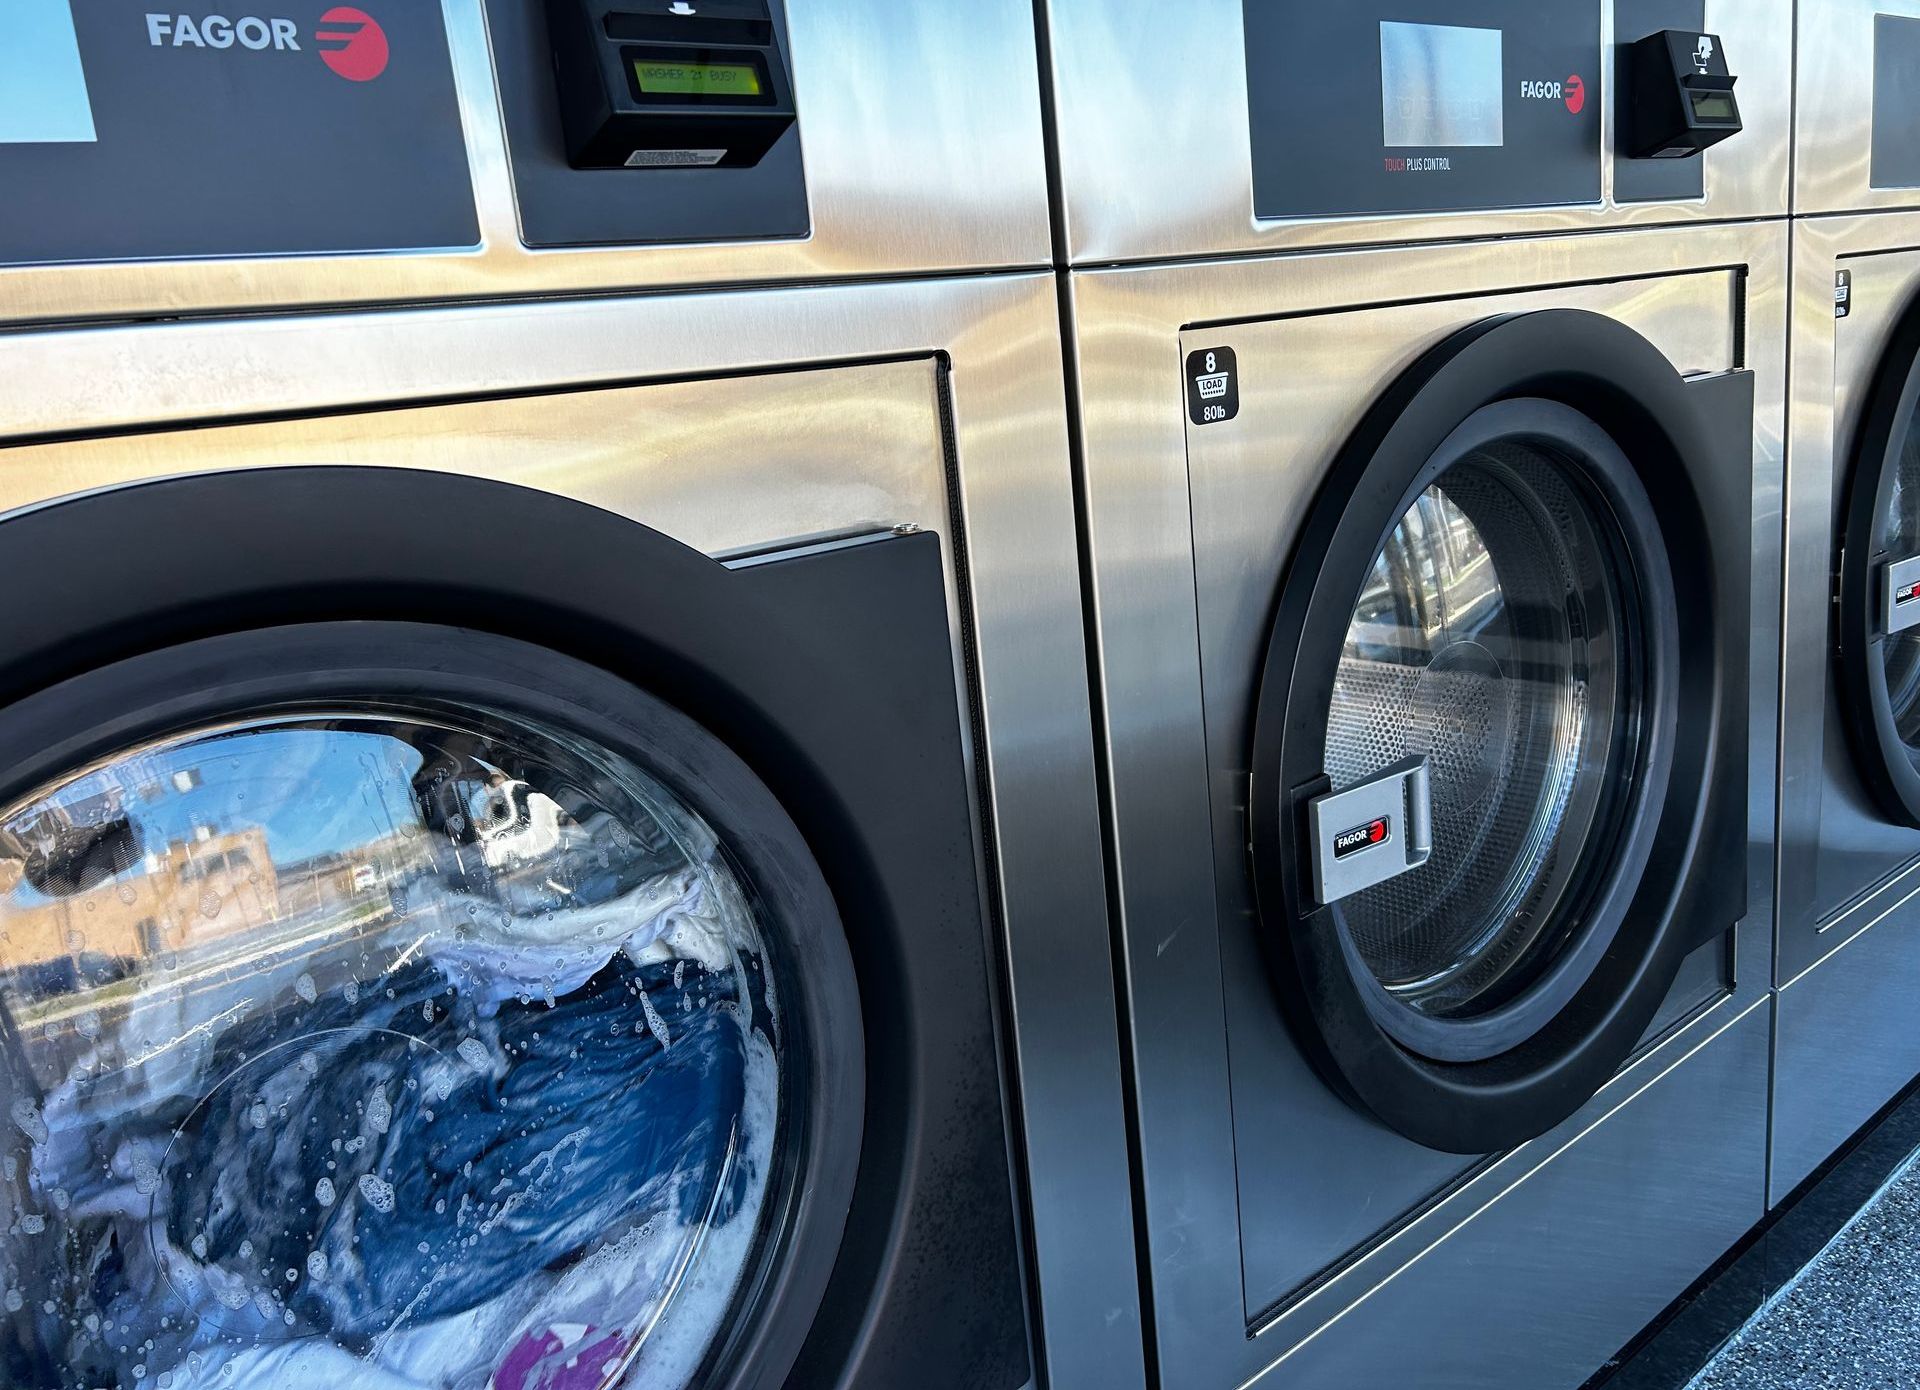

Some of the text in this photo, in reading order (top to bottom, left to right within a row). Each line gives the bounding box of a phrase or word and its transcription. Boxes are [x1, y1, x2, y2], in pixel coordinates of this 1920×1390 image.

[145, 13, 302, 51] FAGOR
[642, 67, 684, 80] WASHER
[710, 70, 737, 81] BUSY
[1520, 80, 1561, 100] FAGOR
[1384, 157, 1451, 172] TOUCH PLUS CONTROL
[1205, 351, 1217, 373] 8
[1202, 379, 1223, 391] LOAD
[1203, 405, 1226, 421] 80lb
[1337, 829, 1368, 849] FAGOR
